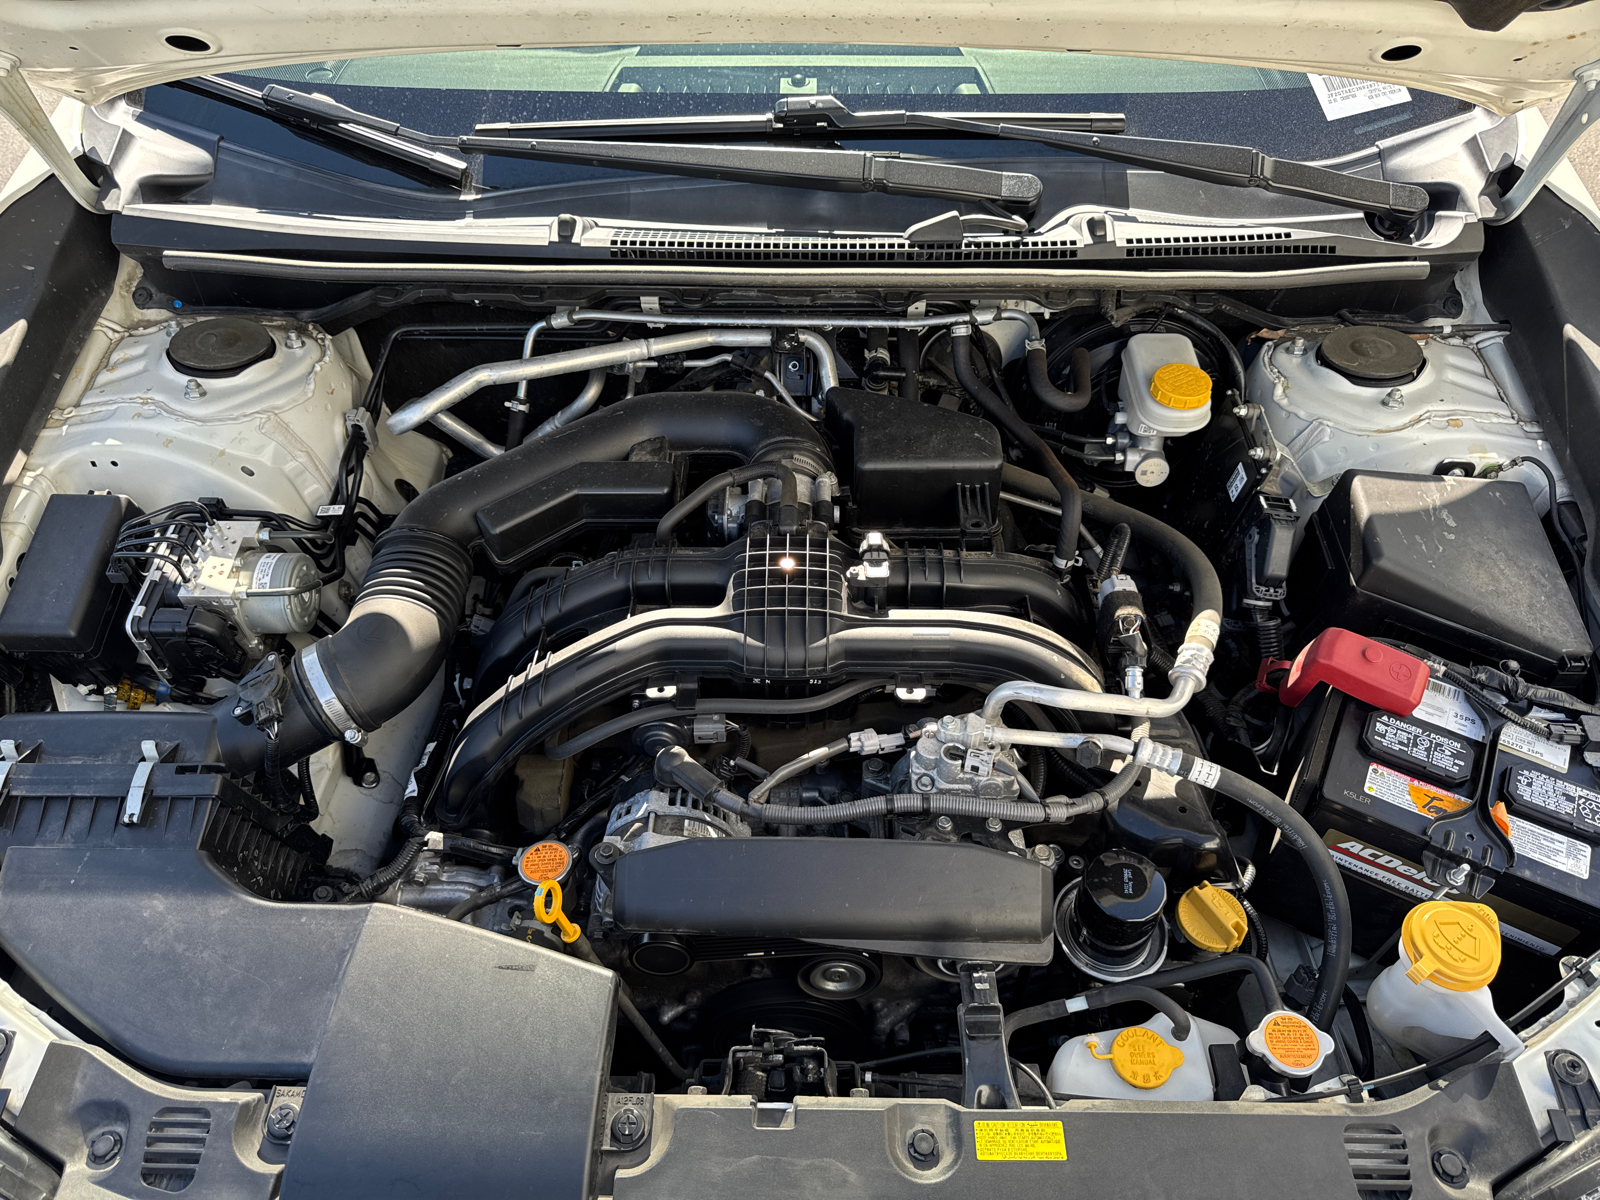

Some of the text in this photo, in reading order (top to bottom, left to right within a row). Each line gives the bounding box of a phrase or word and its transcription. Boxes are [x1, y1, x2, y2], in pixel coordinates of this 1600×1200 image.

[1454, 712, 1476, 725] 35PS
[1389, 718, 1423, 734] DANGER
[1429, 733, 1461, 749] POISON
[1499, 737, 1544, 757] 65270 35PS
[1330, 854, 1380, 879] AINTENANCE
[1404, 884, 1430, 899] BATTE
[1336, 841, 1460, 894] ACDel
[1500, 930, 1545, 951] TENIMIENTO
[1116, 1029, 1164, 1048] COOLANT
